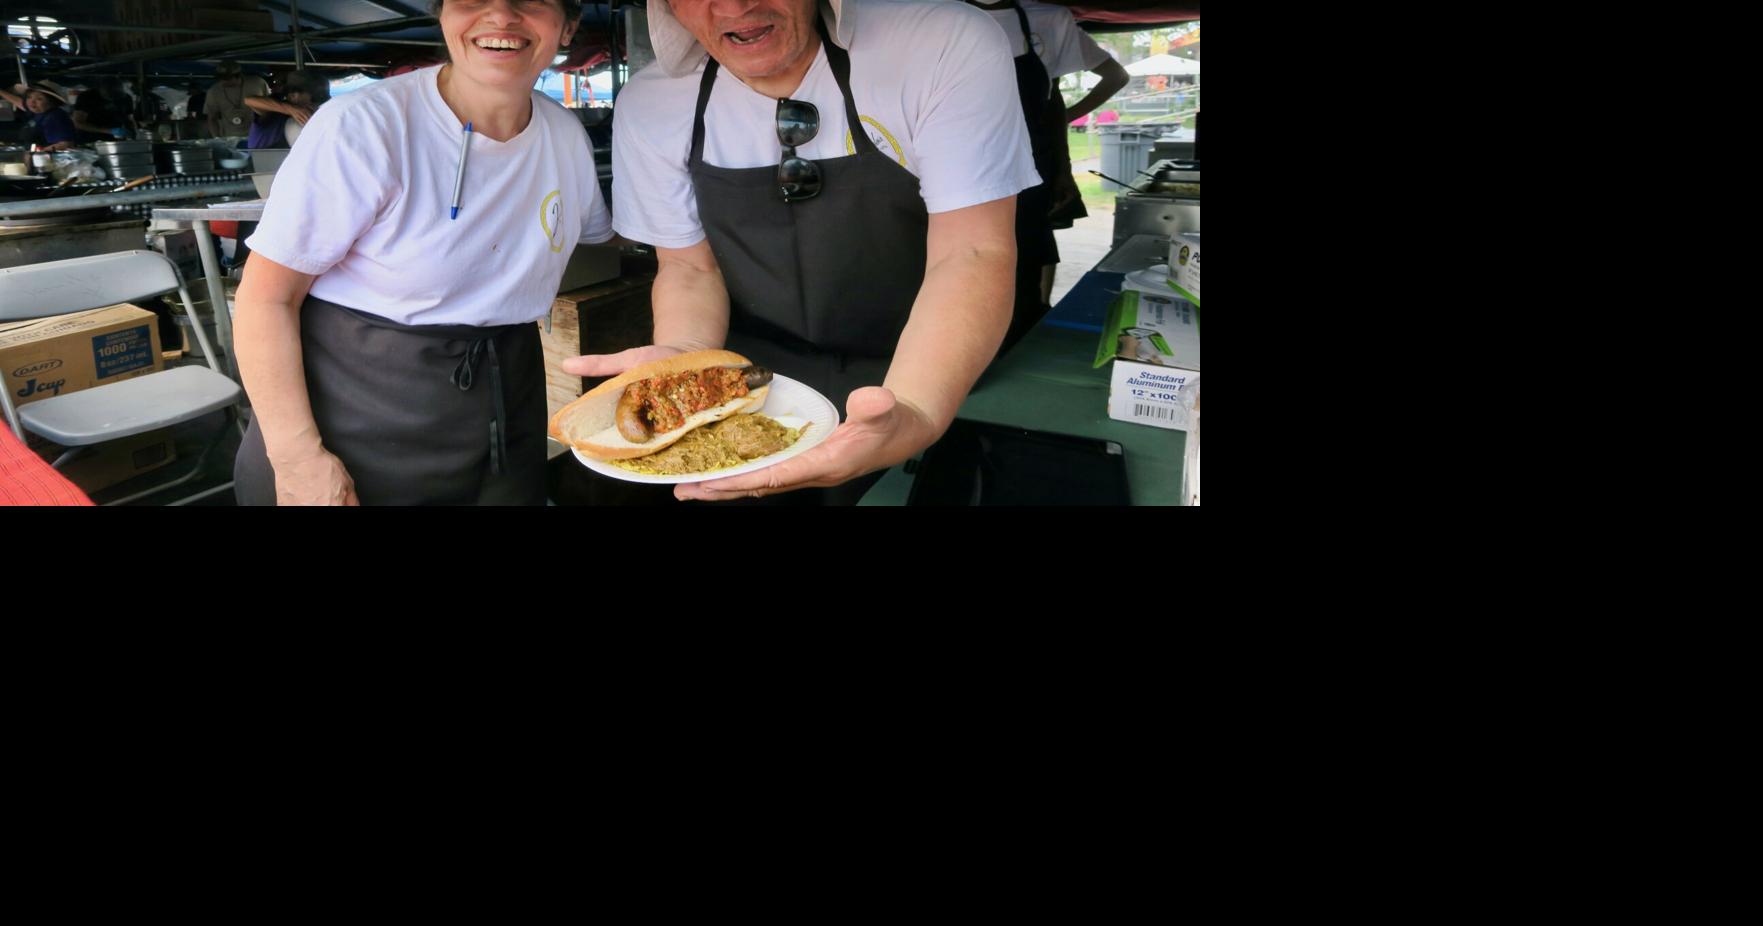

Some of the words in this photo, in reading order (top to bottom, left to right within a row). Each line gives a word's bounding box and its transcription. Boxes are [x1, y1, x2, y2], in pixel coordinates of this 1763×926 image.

[98, 342, 127, 358] 1000
[18, 361, 59, 376] DART
[1126, 377, 1176, 391] Aluminum
[1139, 371, 1186, 384] Standard
